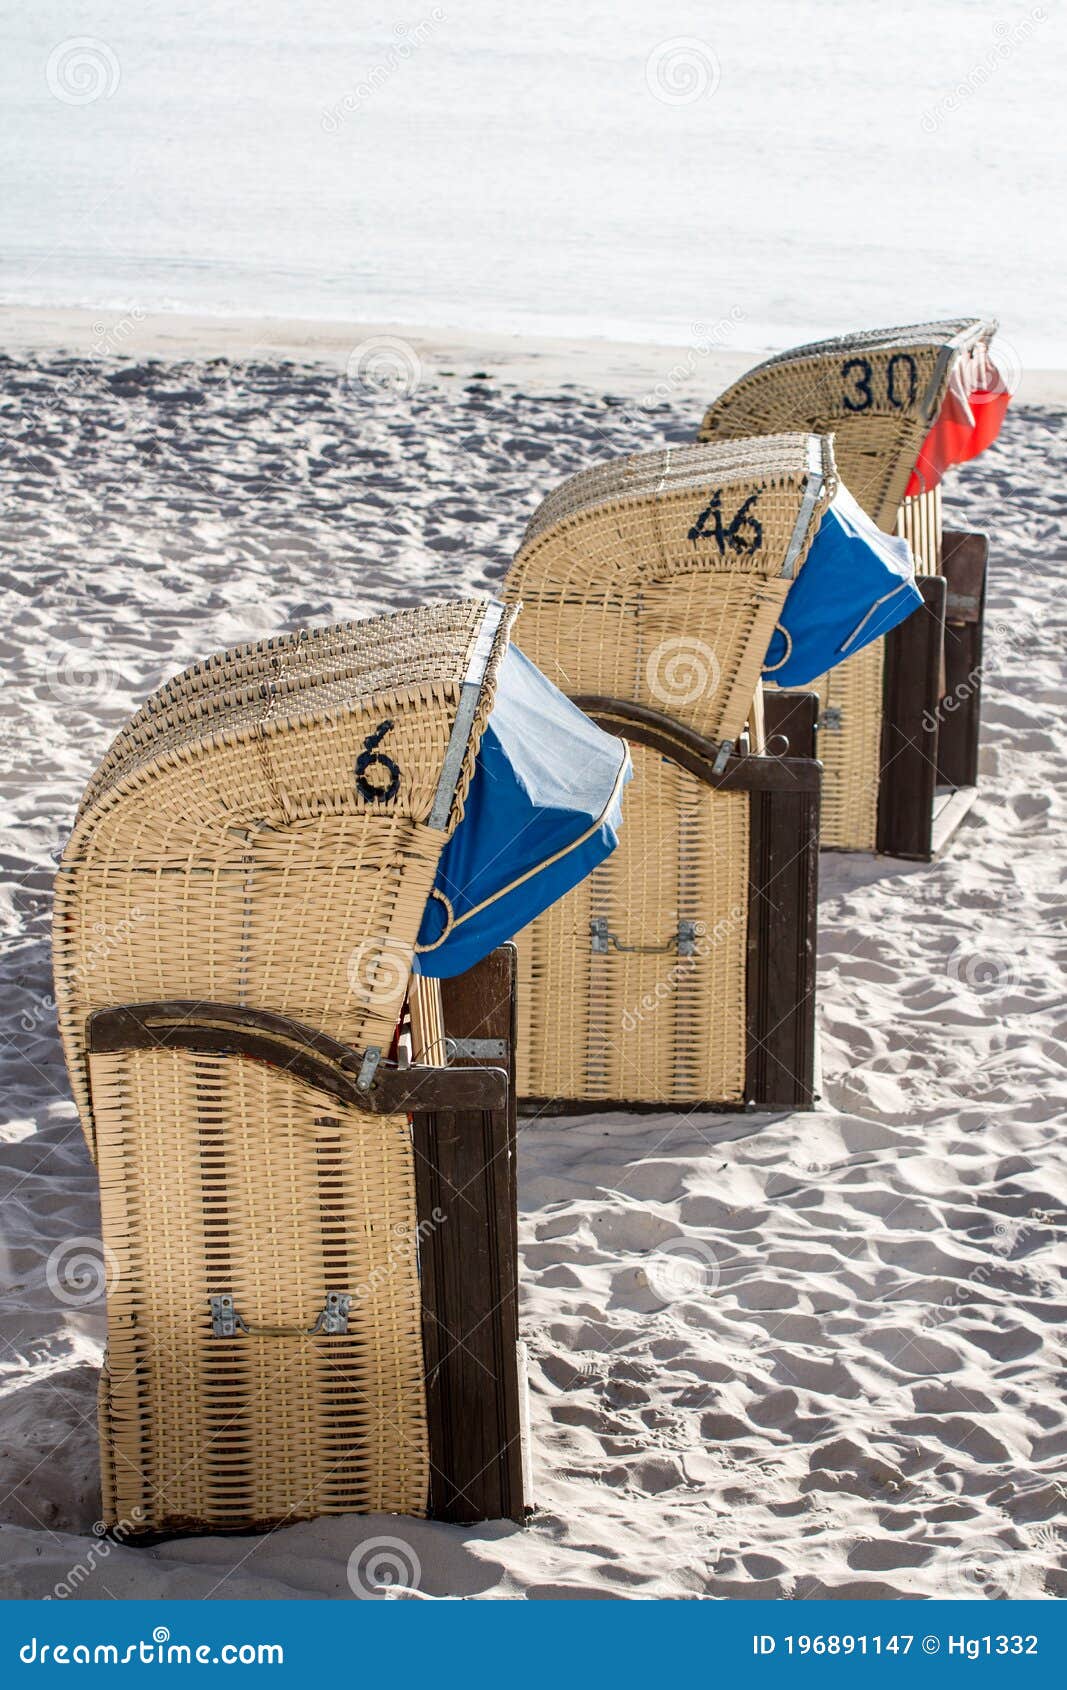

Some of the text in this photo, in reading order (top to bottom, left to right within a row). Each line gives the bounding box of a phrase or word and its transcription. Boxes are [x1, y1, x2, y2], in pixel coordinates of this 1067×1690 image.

[842, 354, 917, 412] 30
[687, 488, 762, 556] 46
[354, 719, 400, 803] 6
